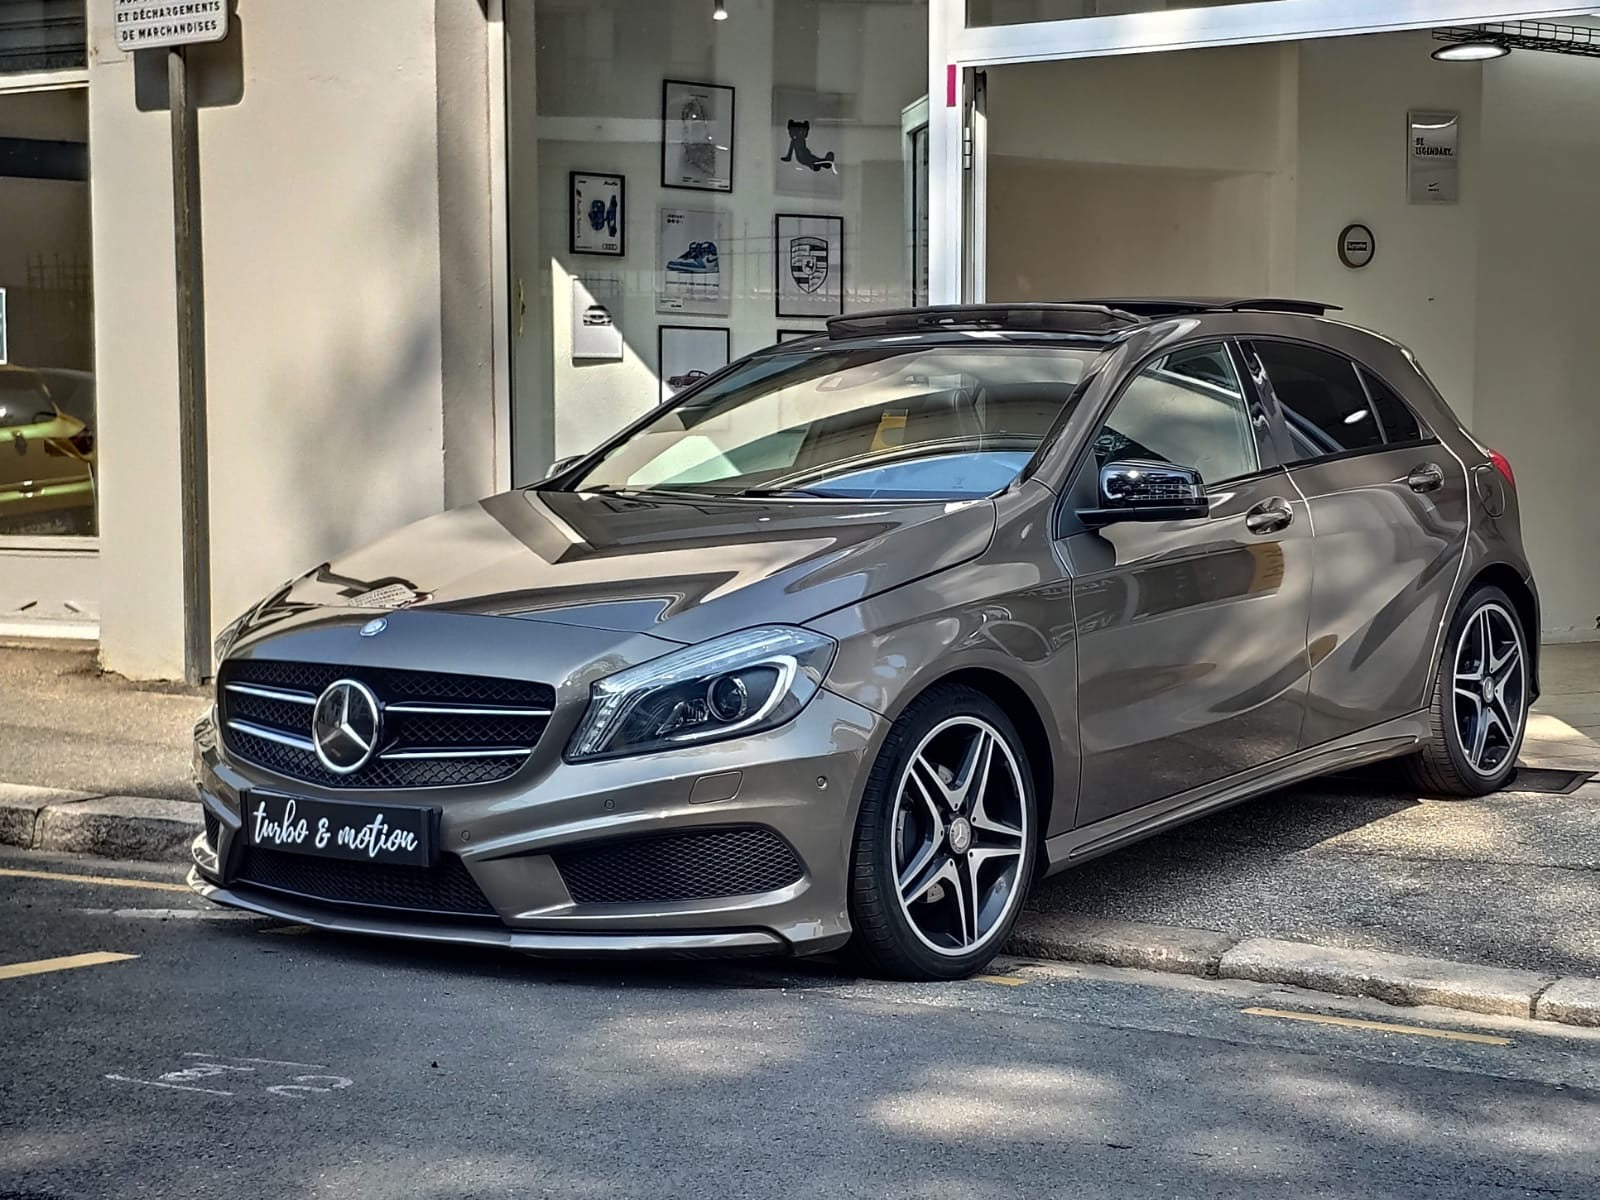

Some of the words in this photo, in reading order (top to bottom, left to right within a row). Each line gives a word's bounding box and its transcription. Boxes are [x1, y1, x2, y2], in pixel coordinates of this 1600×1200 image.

[117, 12, 129, 23] ET
[132, 1, 220, 21] DÉCHARGEMENTS
[122, 30, 135, 41] DE
[138, 20, 217, 40] MARCHANDISES
[253, 799, 309, 844] turbo
[314, 817, 331, 848] &
[337, 813, 418, 858] motion
